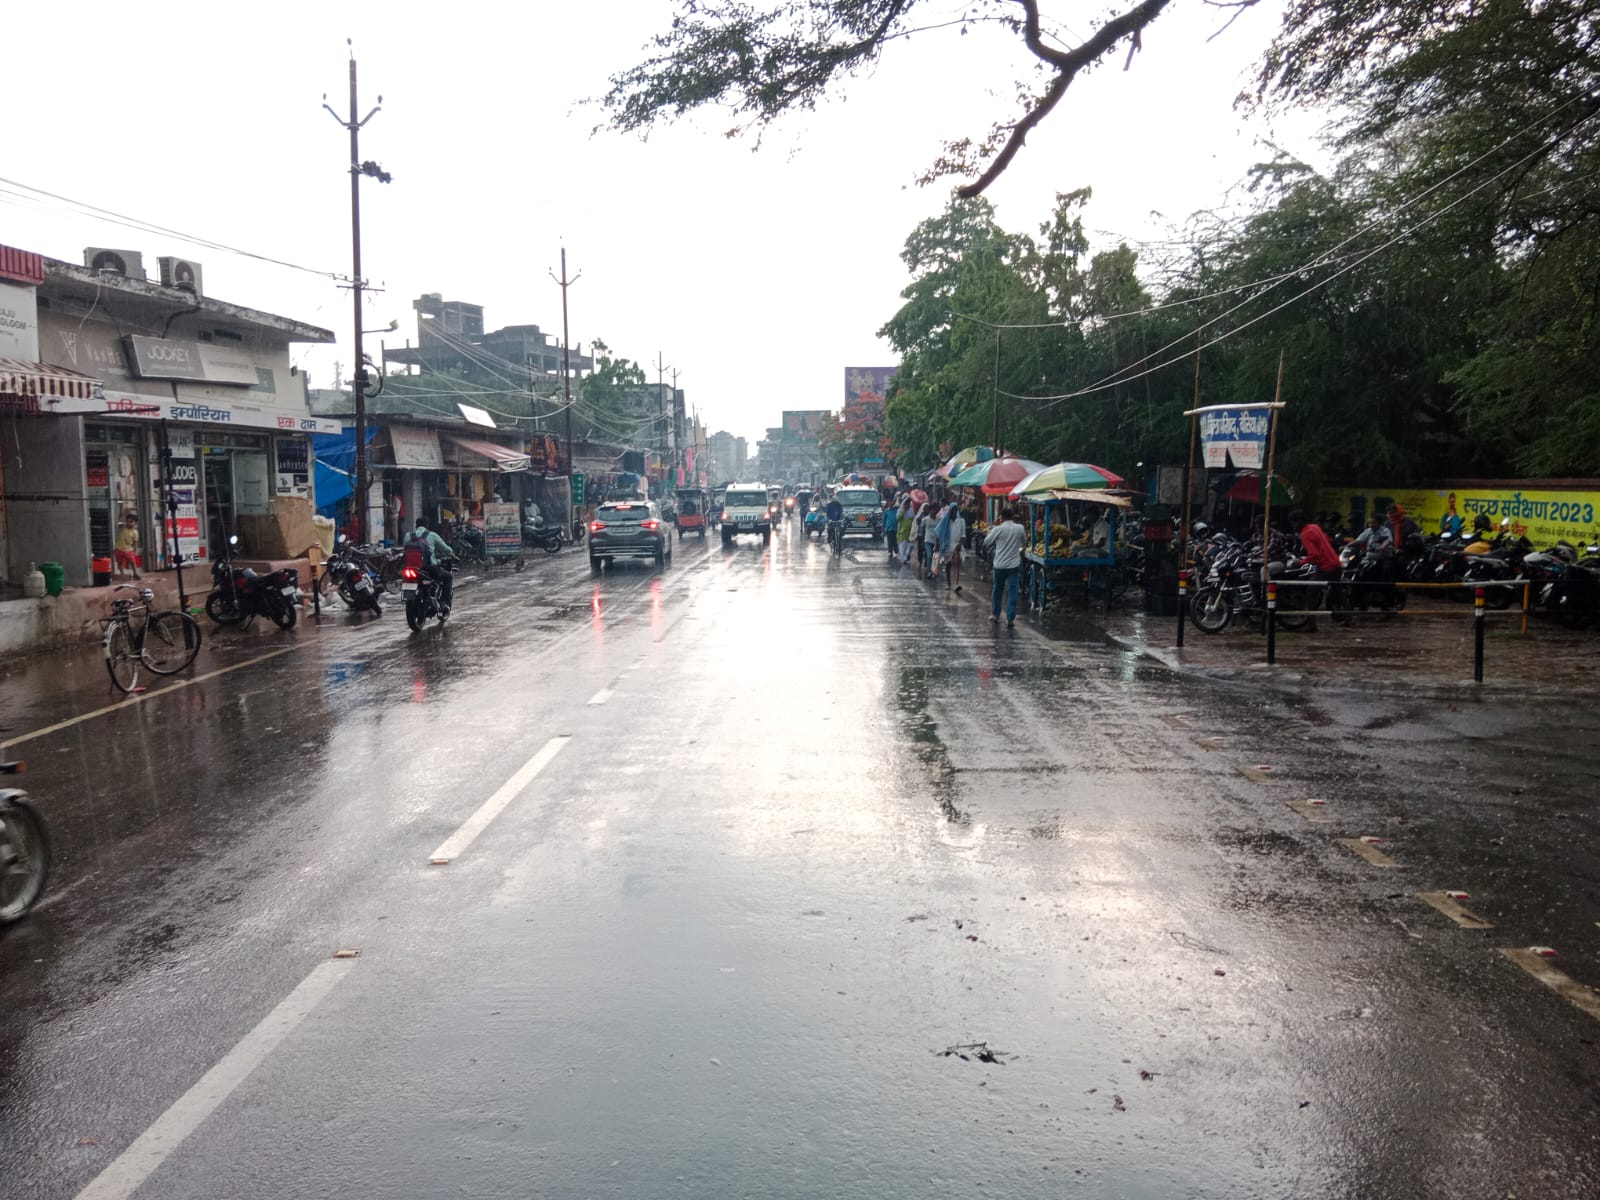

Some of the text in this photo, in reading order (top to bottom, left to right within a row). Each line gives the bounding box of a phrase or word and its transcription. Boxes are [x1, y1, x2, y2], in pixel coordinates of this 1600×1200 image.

[147, 344, 190, 361] JOCKEY
[1501, 493, 1550, 520] सर्वेक्षण
[1549, 501, 1594, 524] 2023
